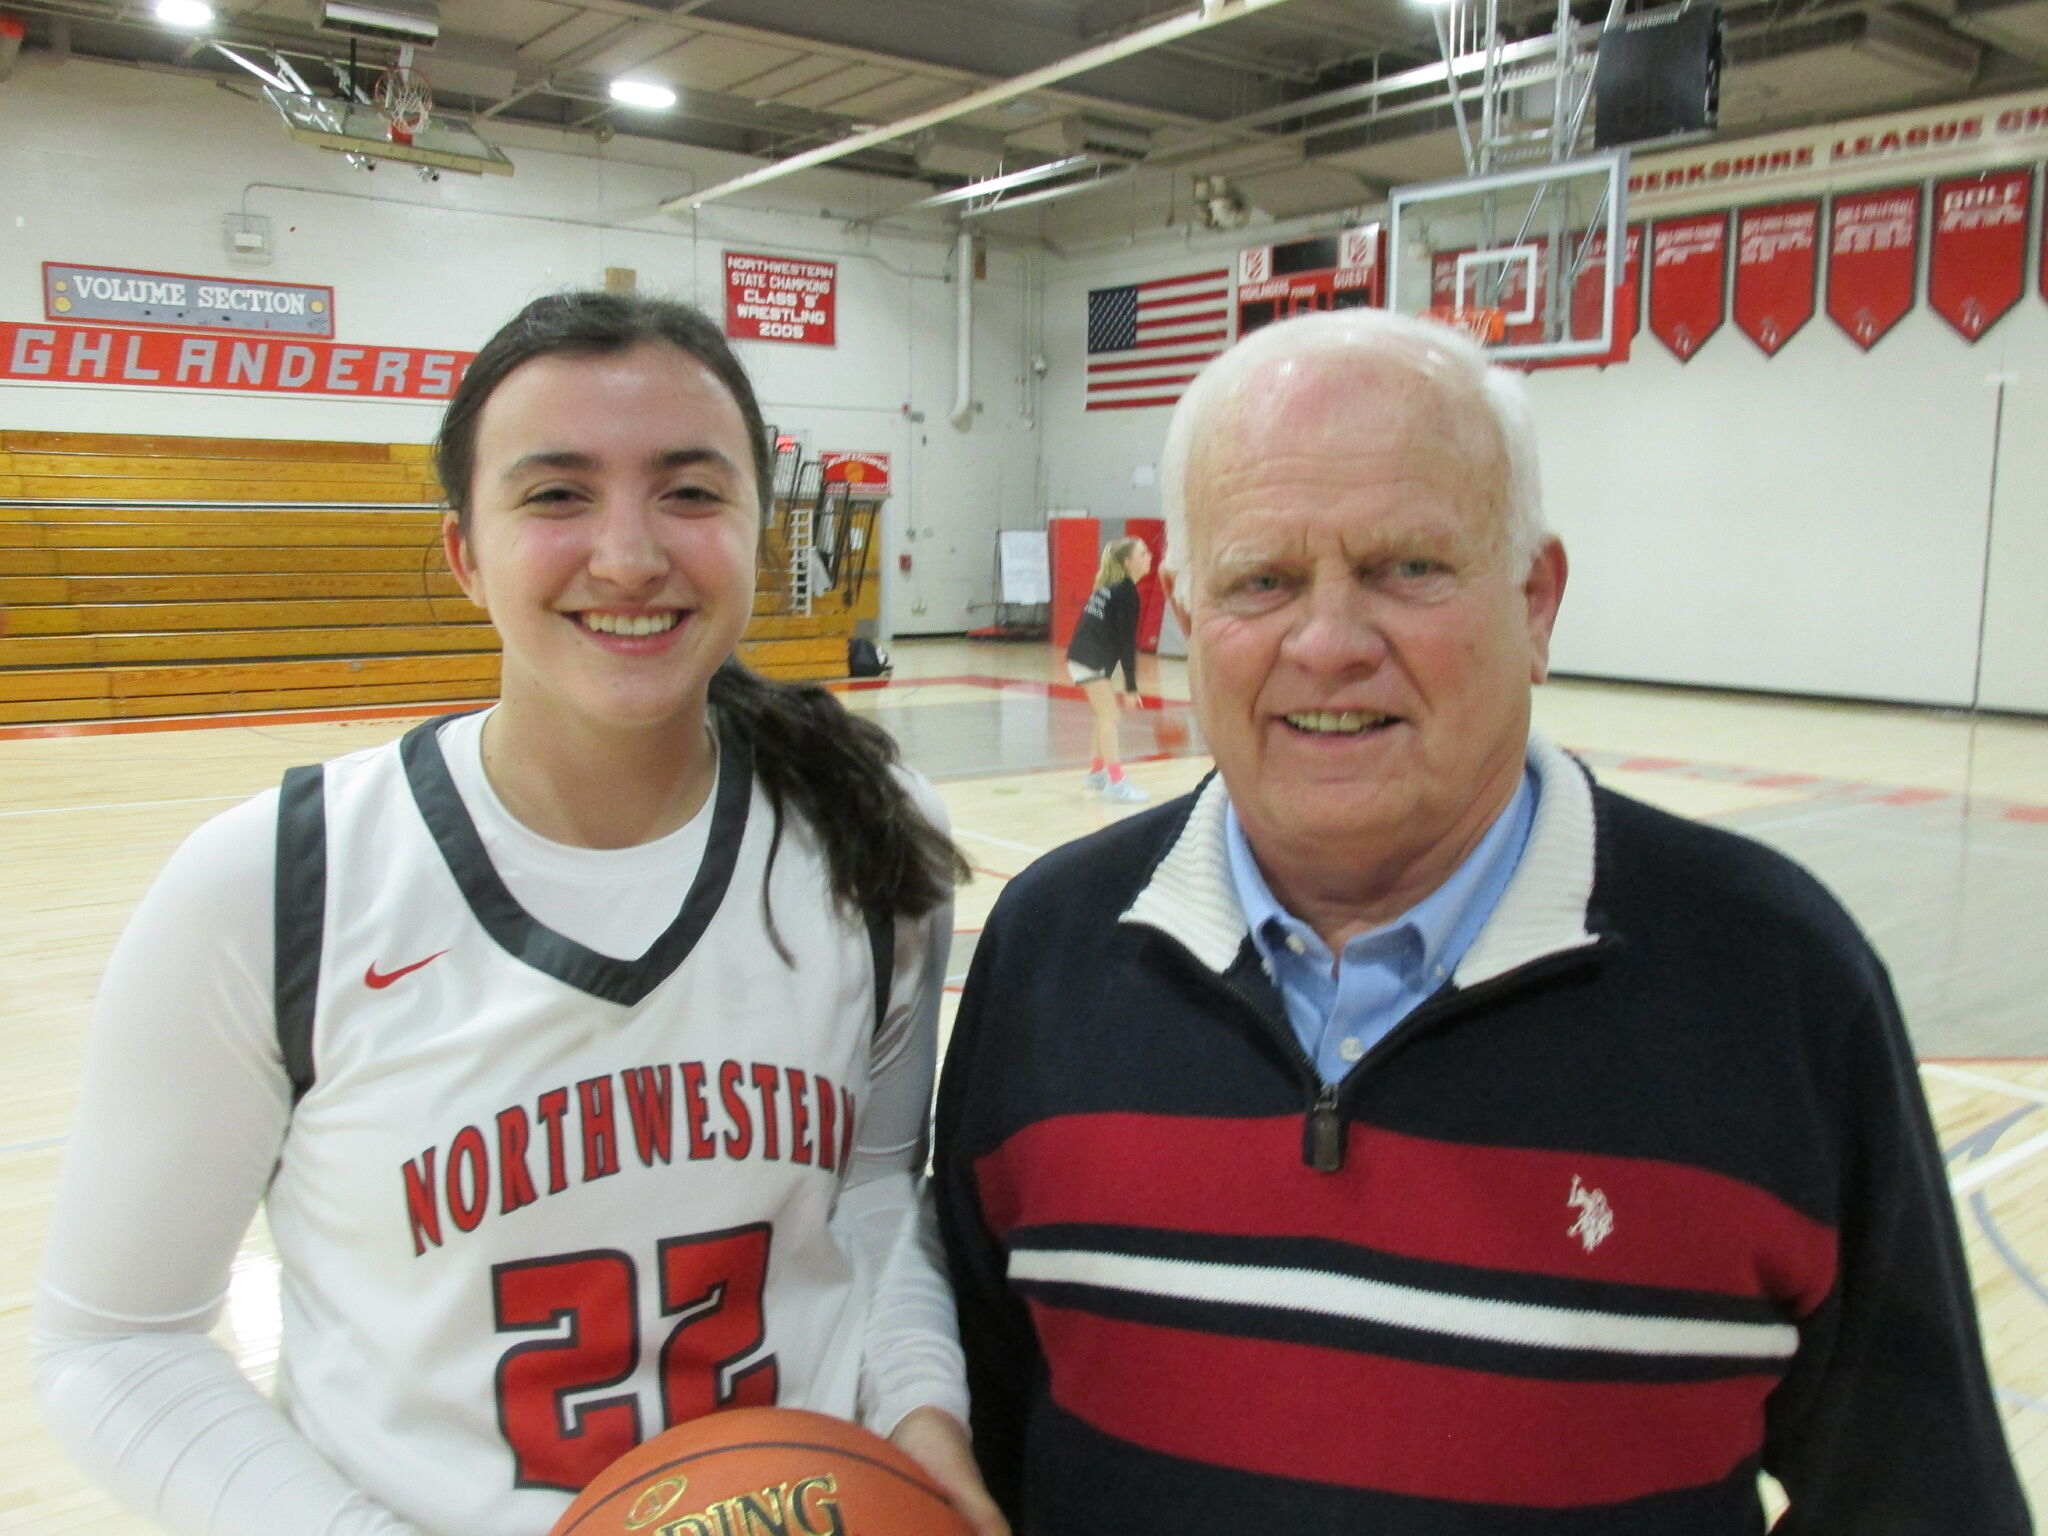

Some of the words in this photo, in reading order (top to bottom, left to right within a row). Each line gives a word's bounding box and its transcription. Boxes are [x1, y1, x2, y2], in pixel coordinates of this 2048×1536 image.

[1832, 116, 1983, 160] LEAGUE
[727, 256, 834, 279] NORTHWESTERN
[731, 272, 766, 287] STATE
[769, 276, 830, 294] CHAMPIONS
[73, 274, 187, 308] VOLUME
[197, 286, 305, 316] SECTION
[743, 289, 797, 307] CLASS
[737, 304, 826, 326] WRESTLING
[10, 328, 455, 394] GHLANDERS
[491, 1221, 778, 1493] 22
